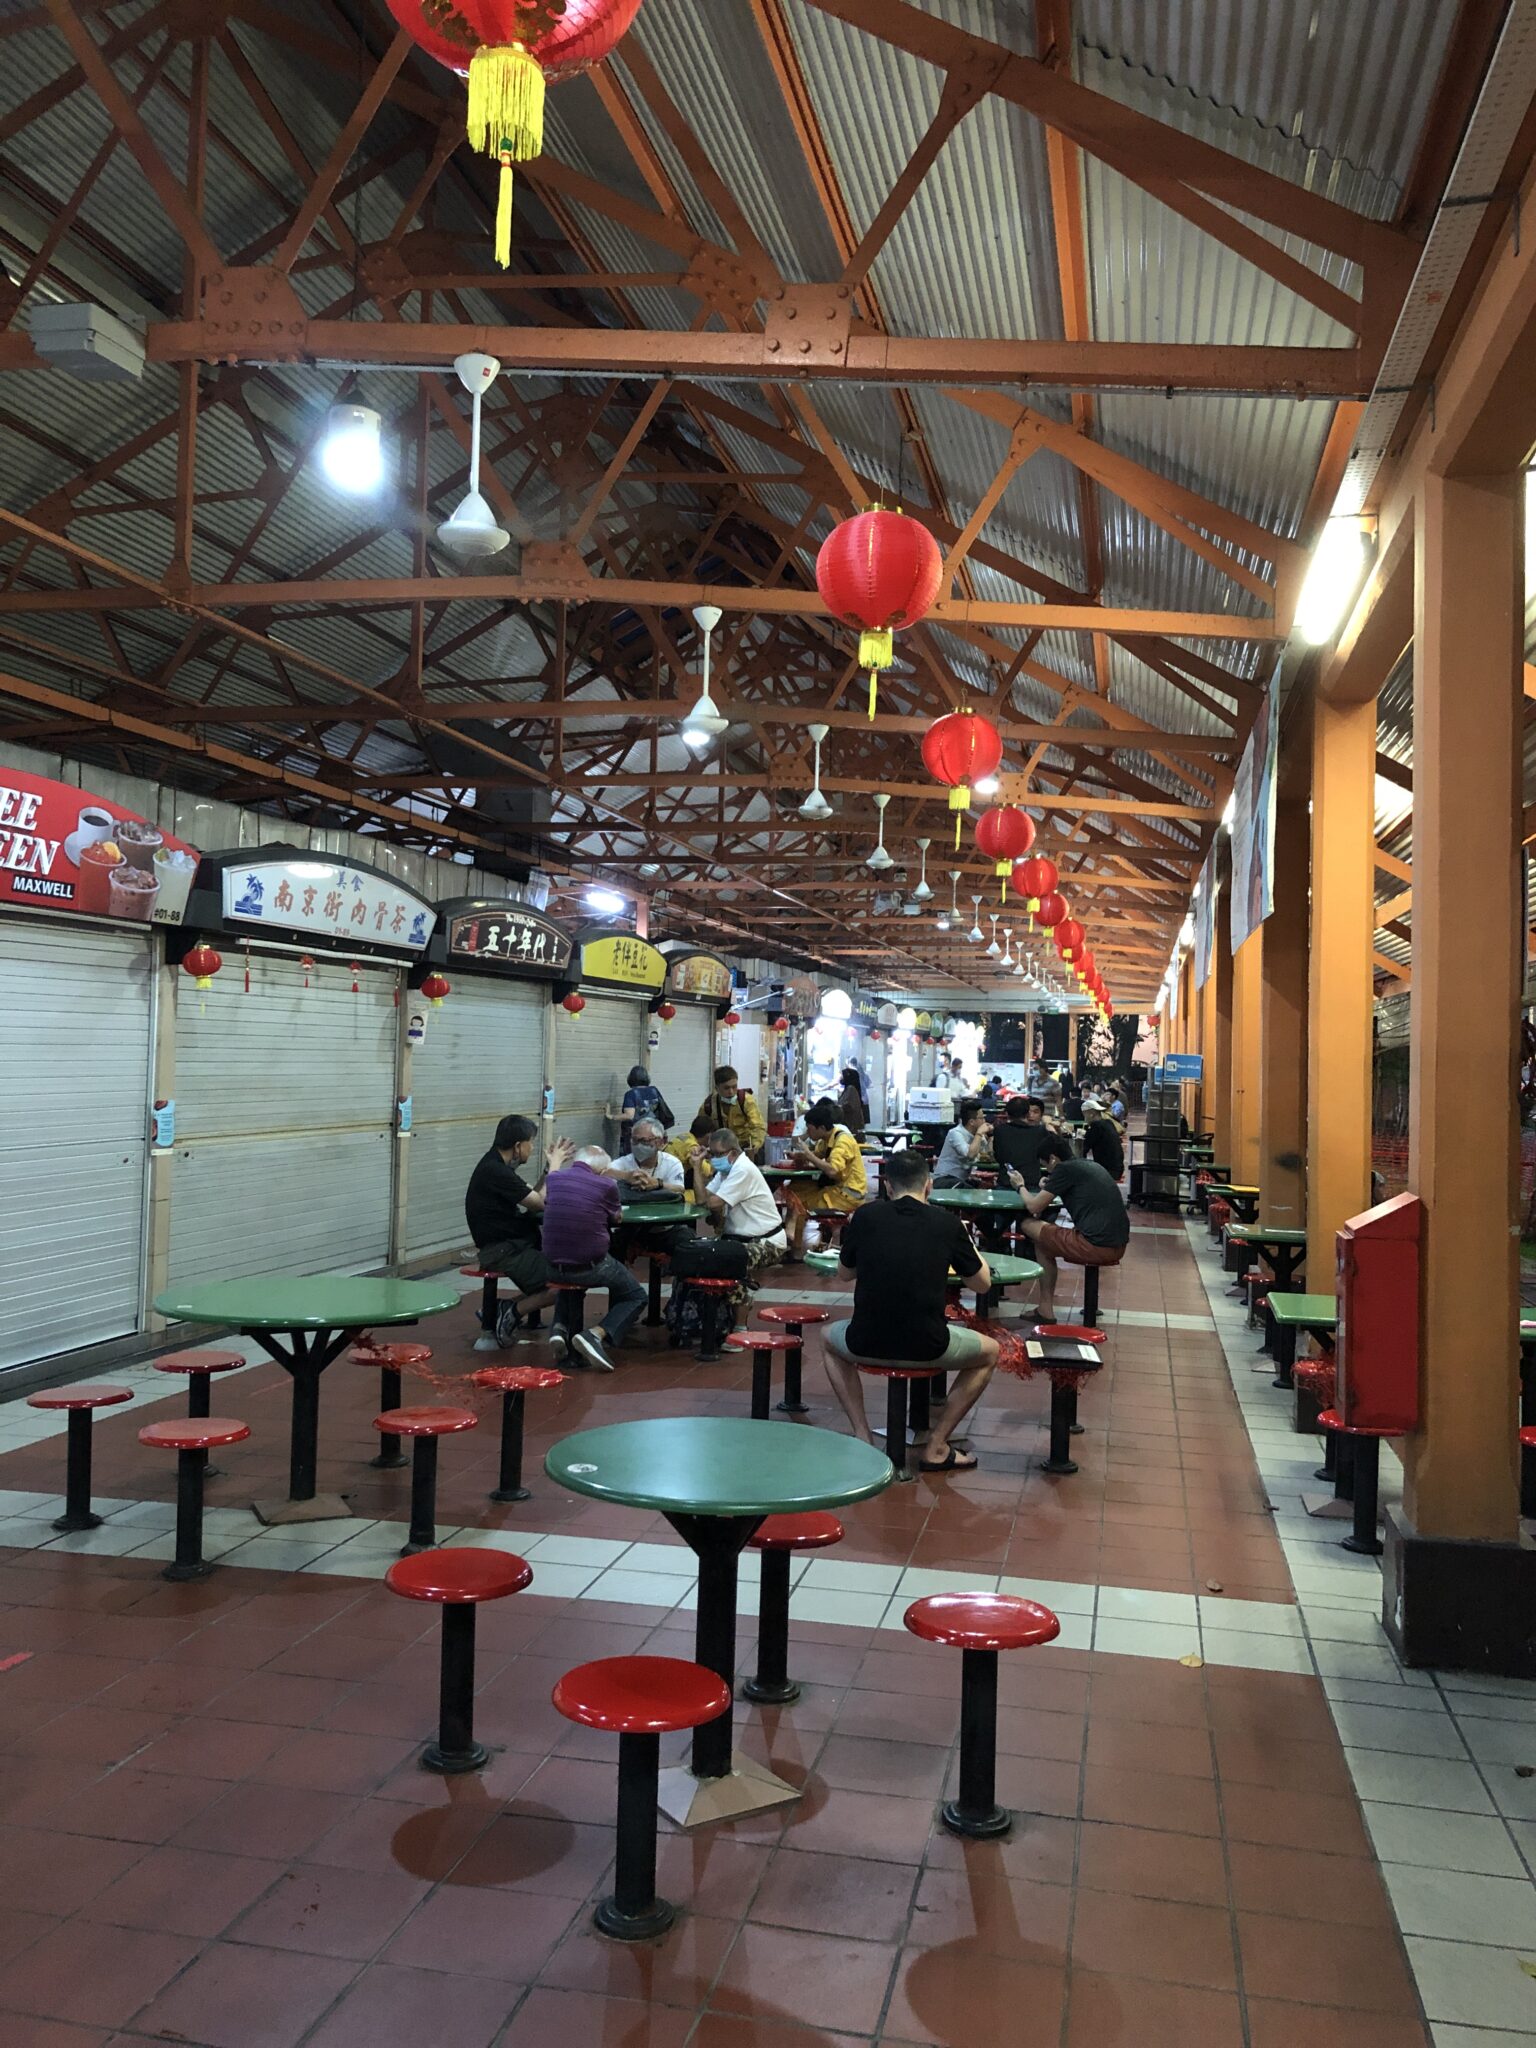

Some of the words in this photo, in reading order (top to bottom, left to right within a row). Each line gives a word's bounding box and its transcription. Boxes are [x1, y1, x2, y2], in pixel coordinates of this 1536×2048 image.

[13, 876, 73, 898] MAXWELL
[273, 879, 406, 934] 南京街肉骨茶
